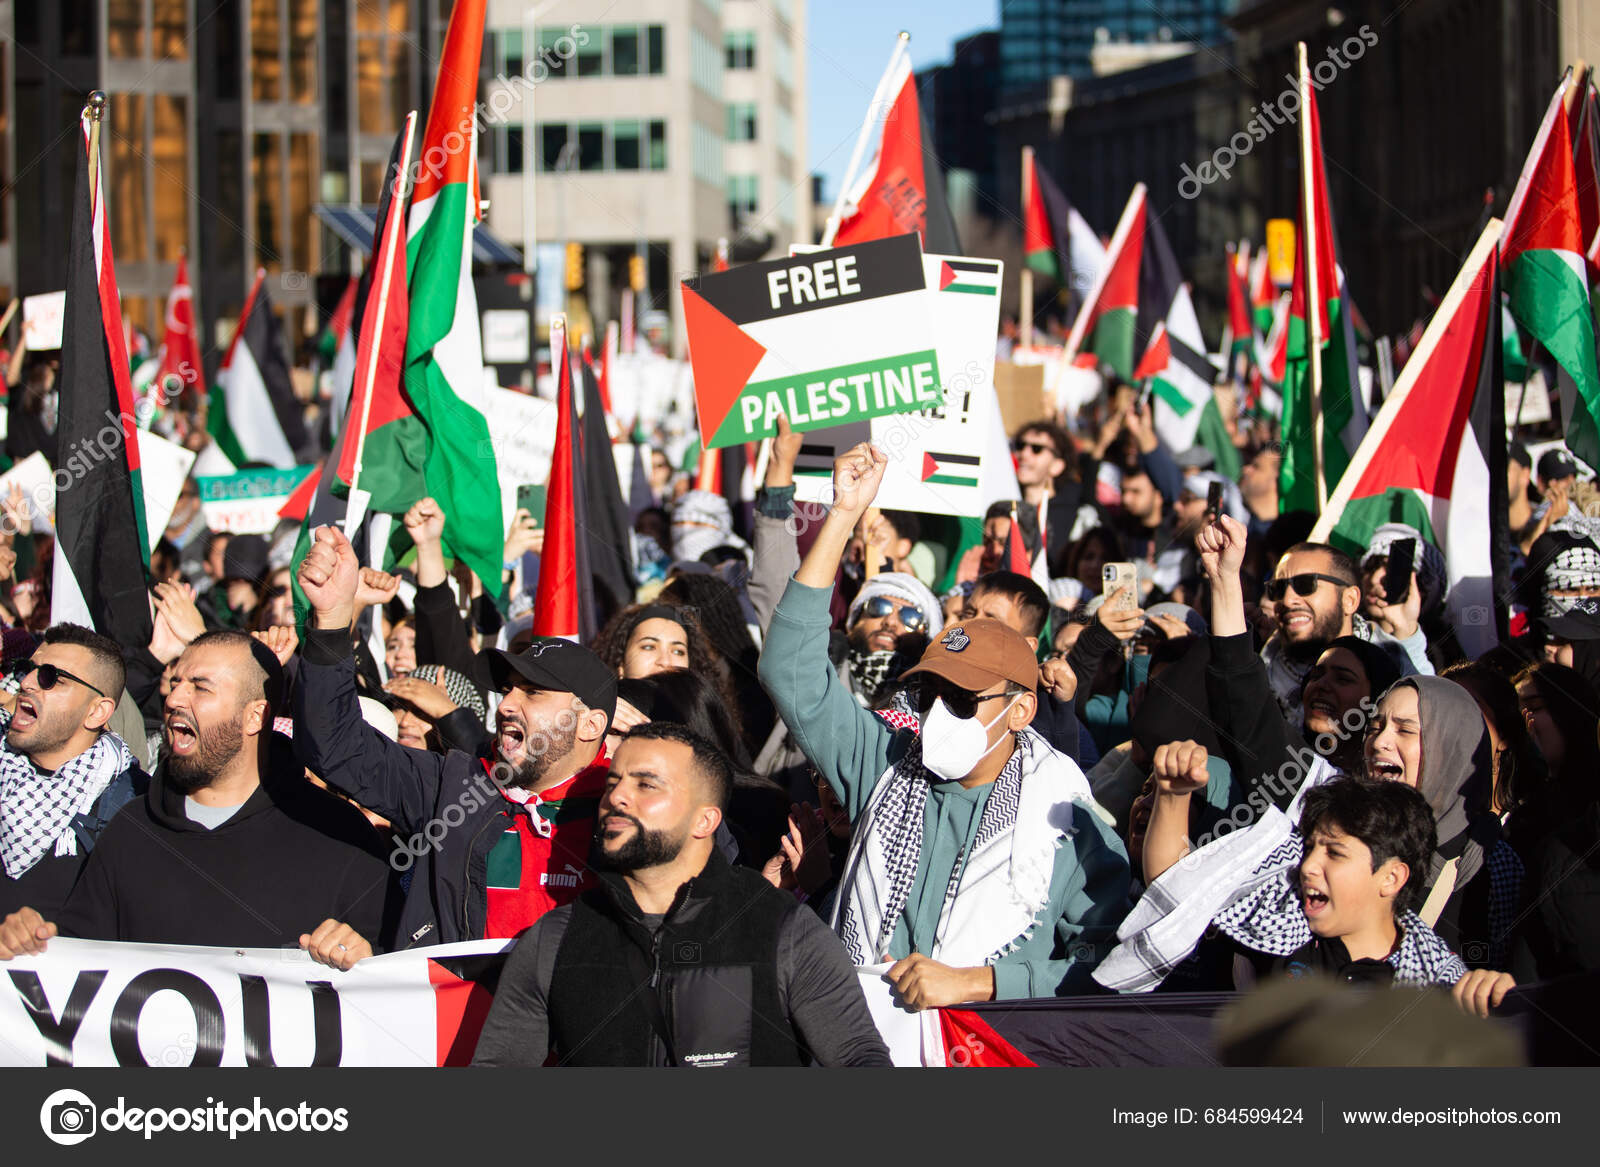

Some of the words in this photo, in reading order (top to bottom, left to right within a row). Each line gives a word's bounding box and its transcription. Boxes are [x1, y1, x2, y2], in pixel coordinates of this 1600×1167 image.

[767, 256, 861, 309] FREE
[740, 362, 937, 434] PALESTINE
[539, 872, 577, 887] PUMA
[7, 967, 343, 1067] YOU
